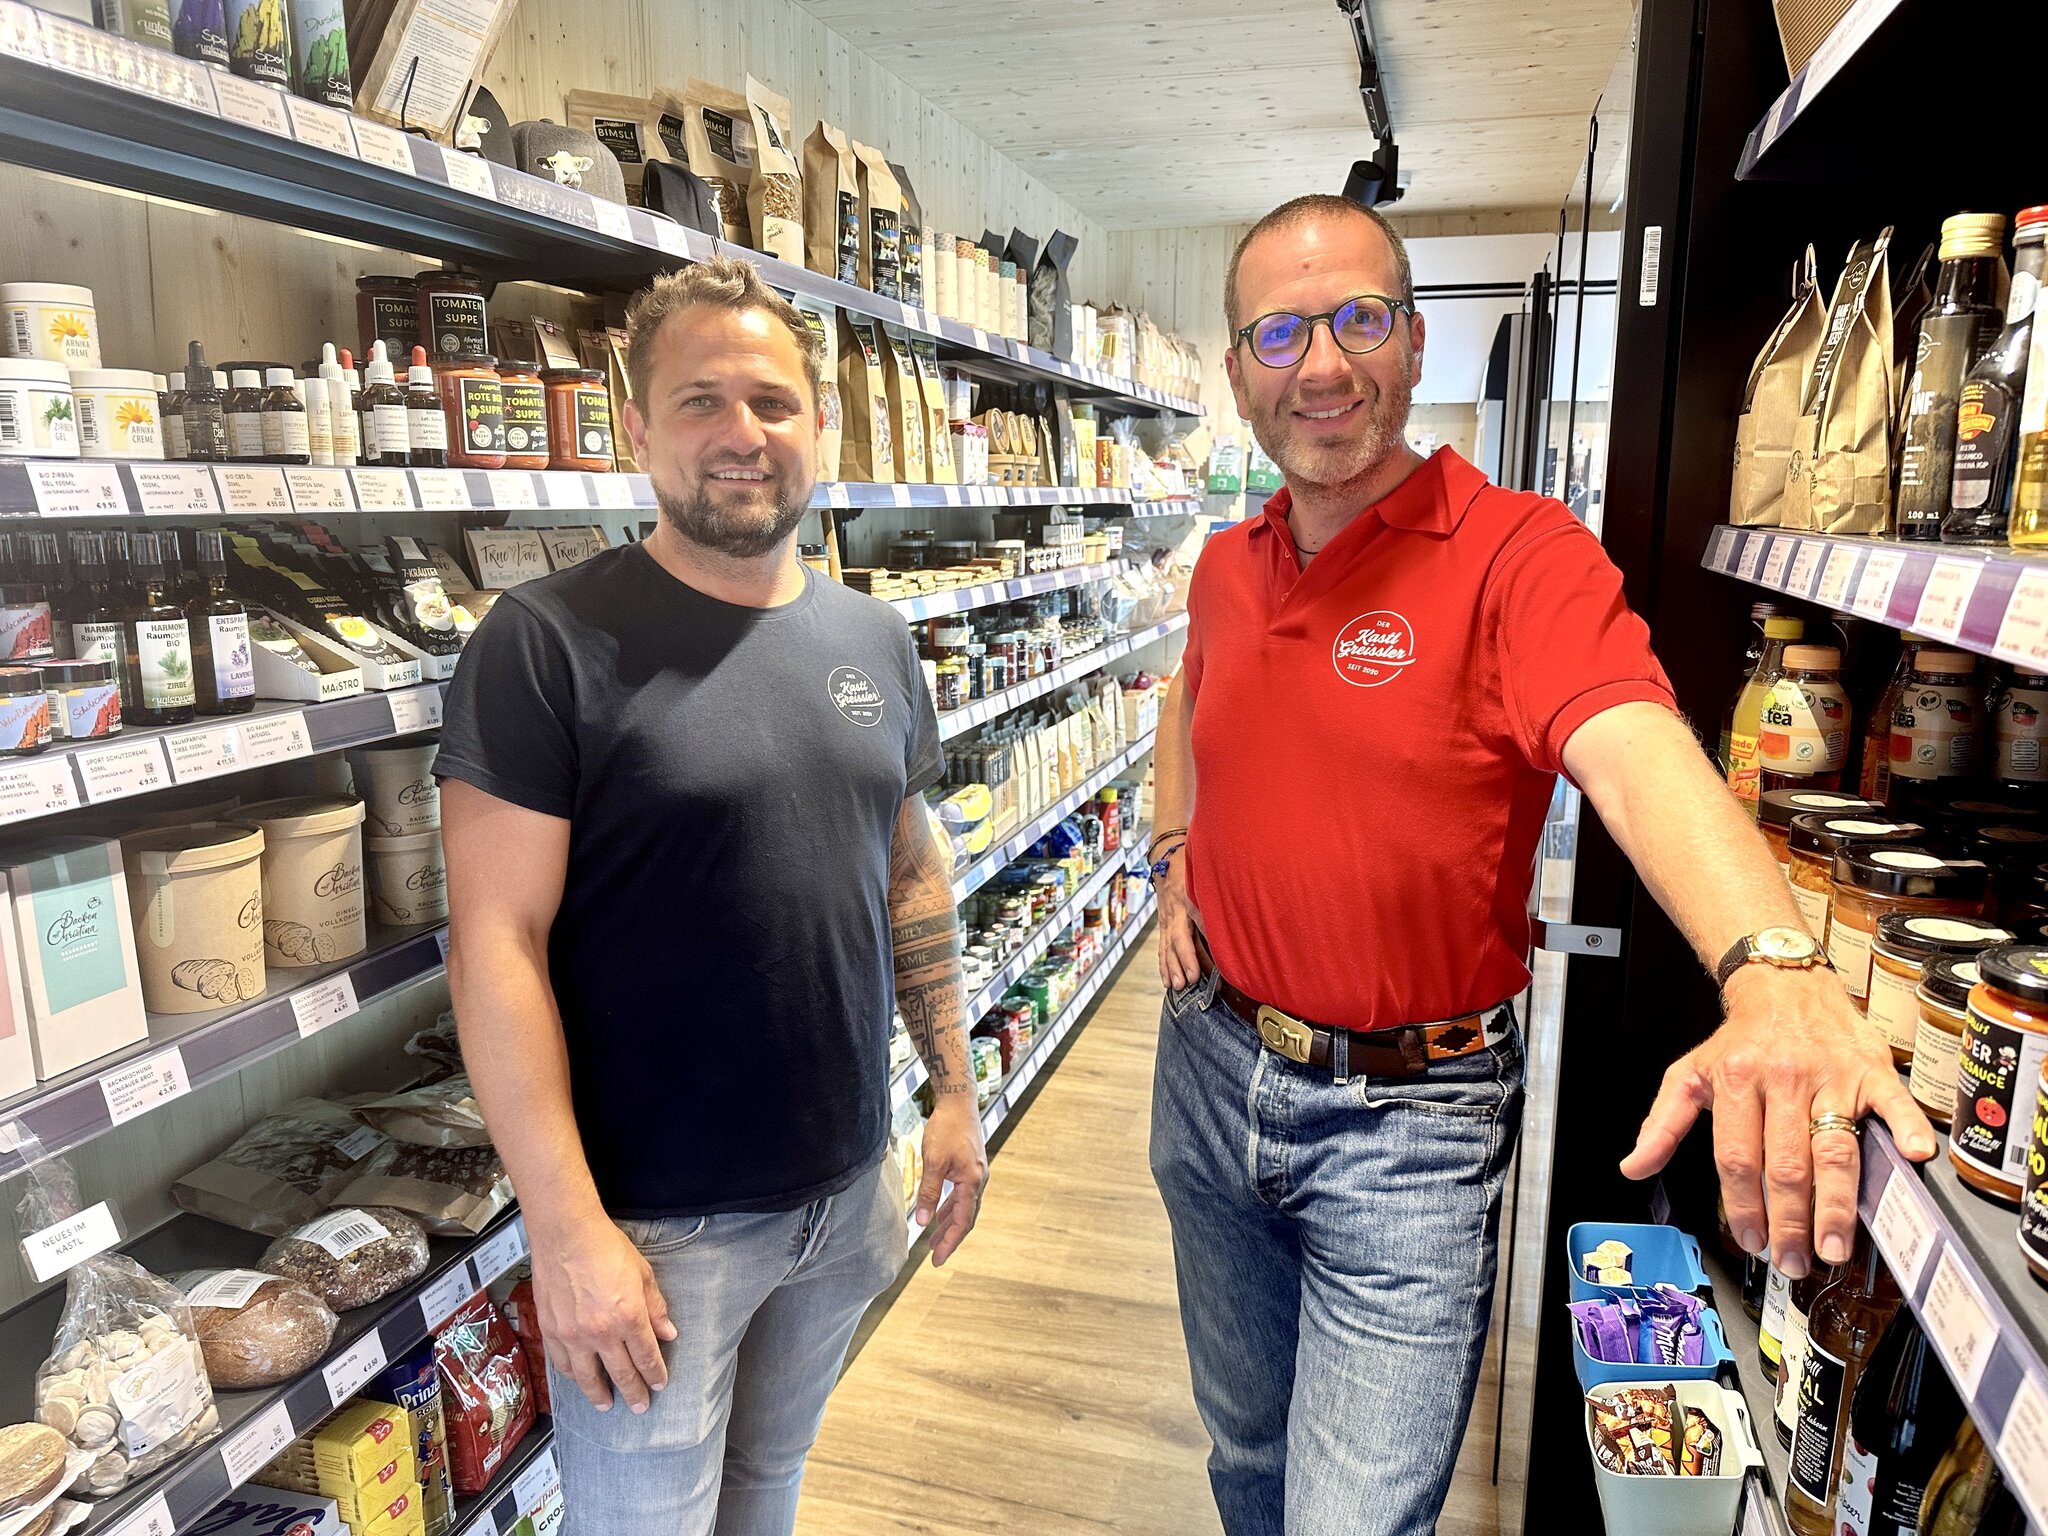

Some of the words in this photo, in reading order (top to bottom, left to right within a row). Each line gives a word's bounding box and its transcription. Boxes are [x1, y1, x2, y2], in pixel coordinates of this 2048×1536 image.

[658, 123, 680, 139] BIMSLI
[704, 118, 731, 137] BIMSLI
[598, 127, 634, 140] BIMSLI
[378, 303, 418, 314] TOMAT
[434, 299, 483, 311] TOMATEN
[389, 318, 417, 328] SUPP
[445, 313, 478, 324] SUPPE
[65, 339, 90, 349] ARNIKA
[66, 348, 89, 358] CREME
[468, 392, 491, 402] ROTE
[515, 409, 542, 419] SUPPE
[54, 421, 75, 432] ZIRBEN
[131, 425, 155, 435] ARNIKA
[54, 432, 67, 441] GEL
[132, 434, 154, 444] CREME
[1907, 511, 1924, 520] 100
[1926, 511, 1940, 520] ml
[1376, 620, 1391, 629] DER
[1355, 628, 1402, 646] Kastl
[100, 642, 116, 650] BIO
[1337, 639, 1407, 660] Greissler
[1347, 663, 1362, 671] SEIT
[1361, 666, 1379, 676] 2020
[166, 680, 188, 690] ZIRBE
[839, 680, 869, 694] Kastl
[833, 691, 879, 708] Greissler
[1772, 702, 1790, 713] Black
[86, 757, 105, 766] SPORT
[106, 749, 149, 762] SCHUTZCREME
[10, 773, 28, 781] AKTIV
[335, 906, 358, 917] DINKEL
[60, 909, 98, 929] Backen
[46, 917, 99, 946] Christina
[107, 1063, 152, 1088] BACKMISCHUNG
[109, 1078, 139, 1096] LUNGAUER
[140, 1071, 154, 1081] BROT
[41, 1228, 73, 1249] NEUES
[73, 1221, 87, 1233] IM
[55, 1237, 84, 1256] KASTL
[1806, 1414, 1828, 1432] dahoam
